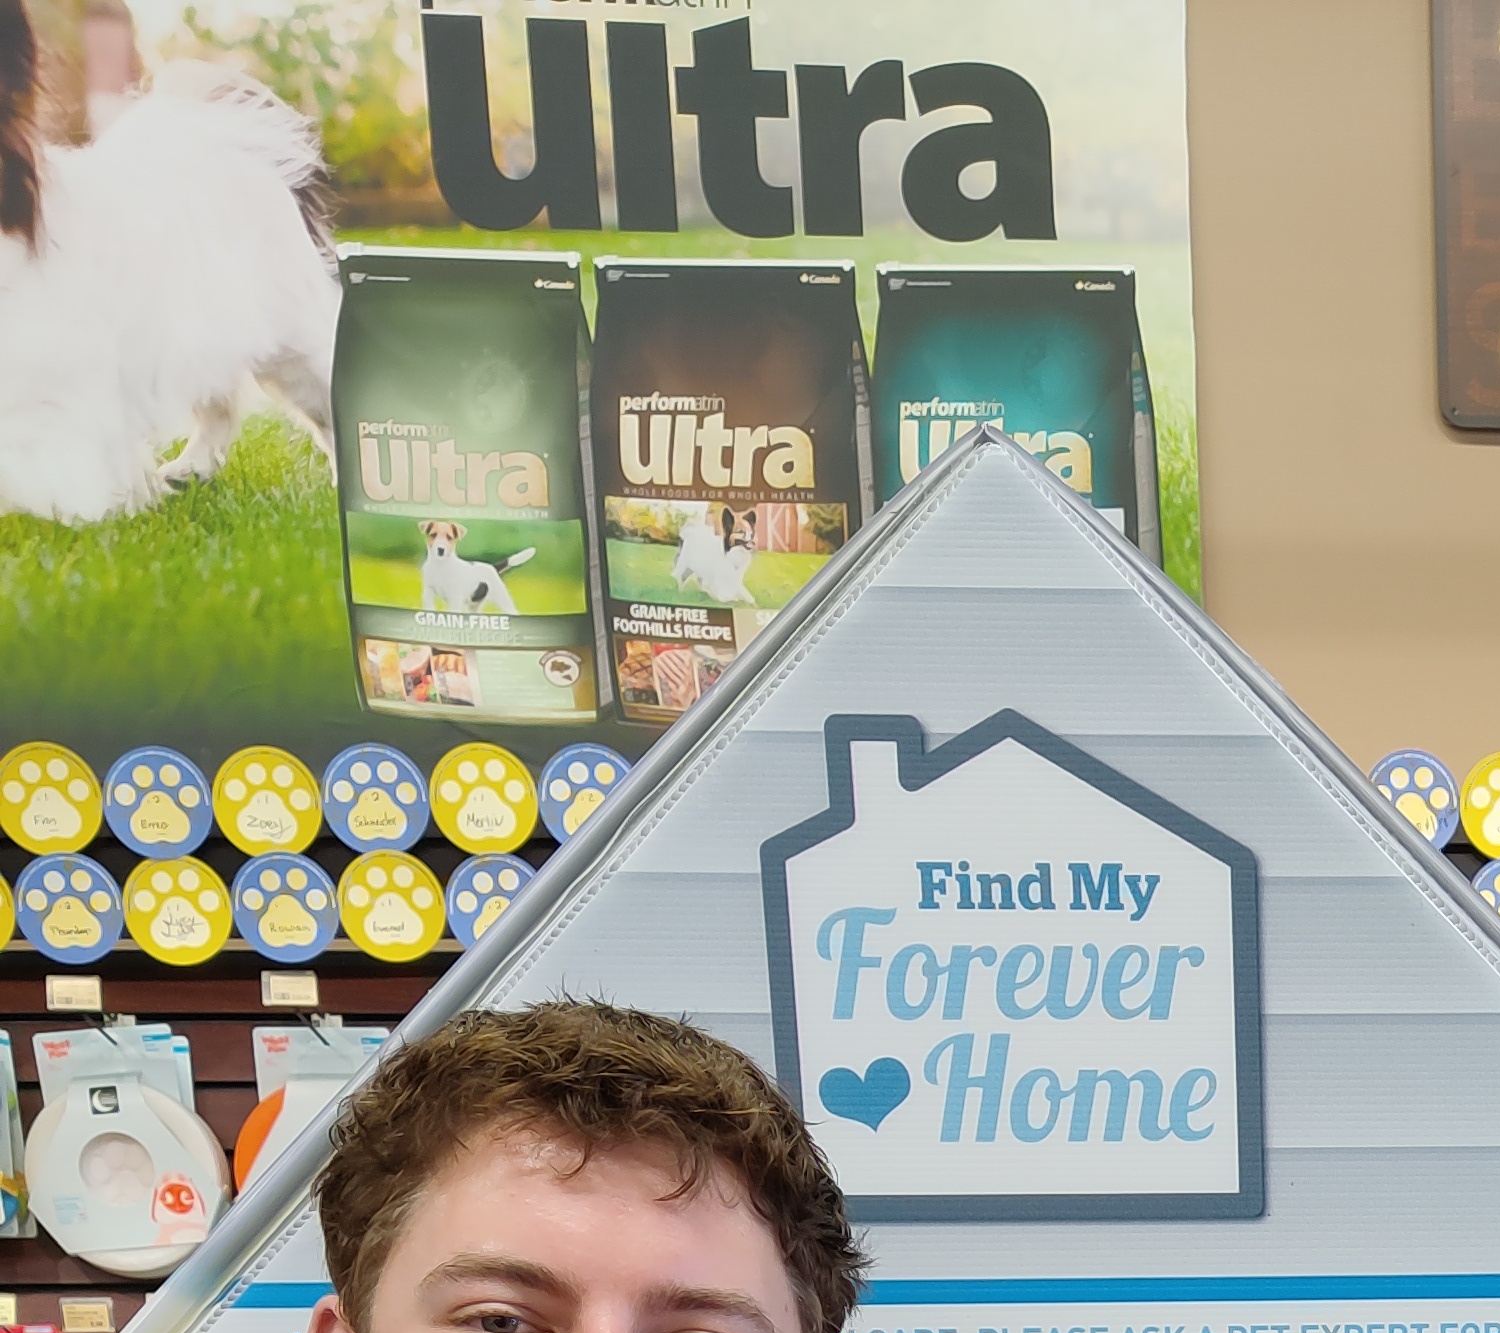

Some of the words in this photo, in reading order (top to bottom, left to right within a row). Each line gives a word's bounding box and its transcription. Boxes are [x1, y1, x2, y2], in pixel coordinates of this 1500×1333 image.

[414, 611, 511, 631] GRAIN-FREE
[612, 616, 683, 638] FOOTHILLS
[684, 624, 733, 641] RECIPE
[629, 603, 709, 623] GRAIN-FREE
[915, 860, 1056, 911] Find
[1068, 862, 1160, 921] My
[815, 906, 1205, 1021] Forever
[922, 1032, 1218, 1143] Home
